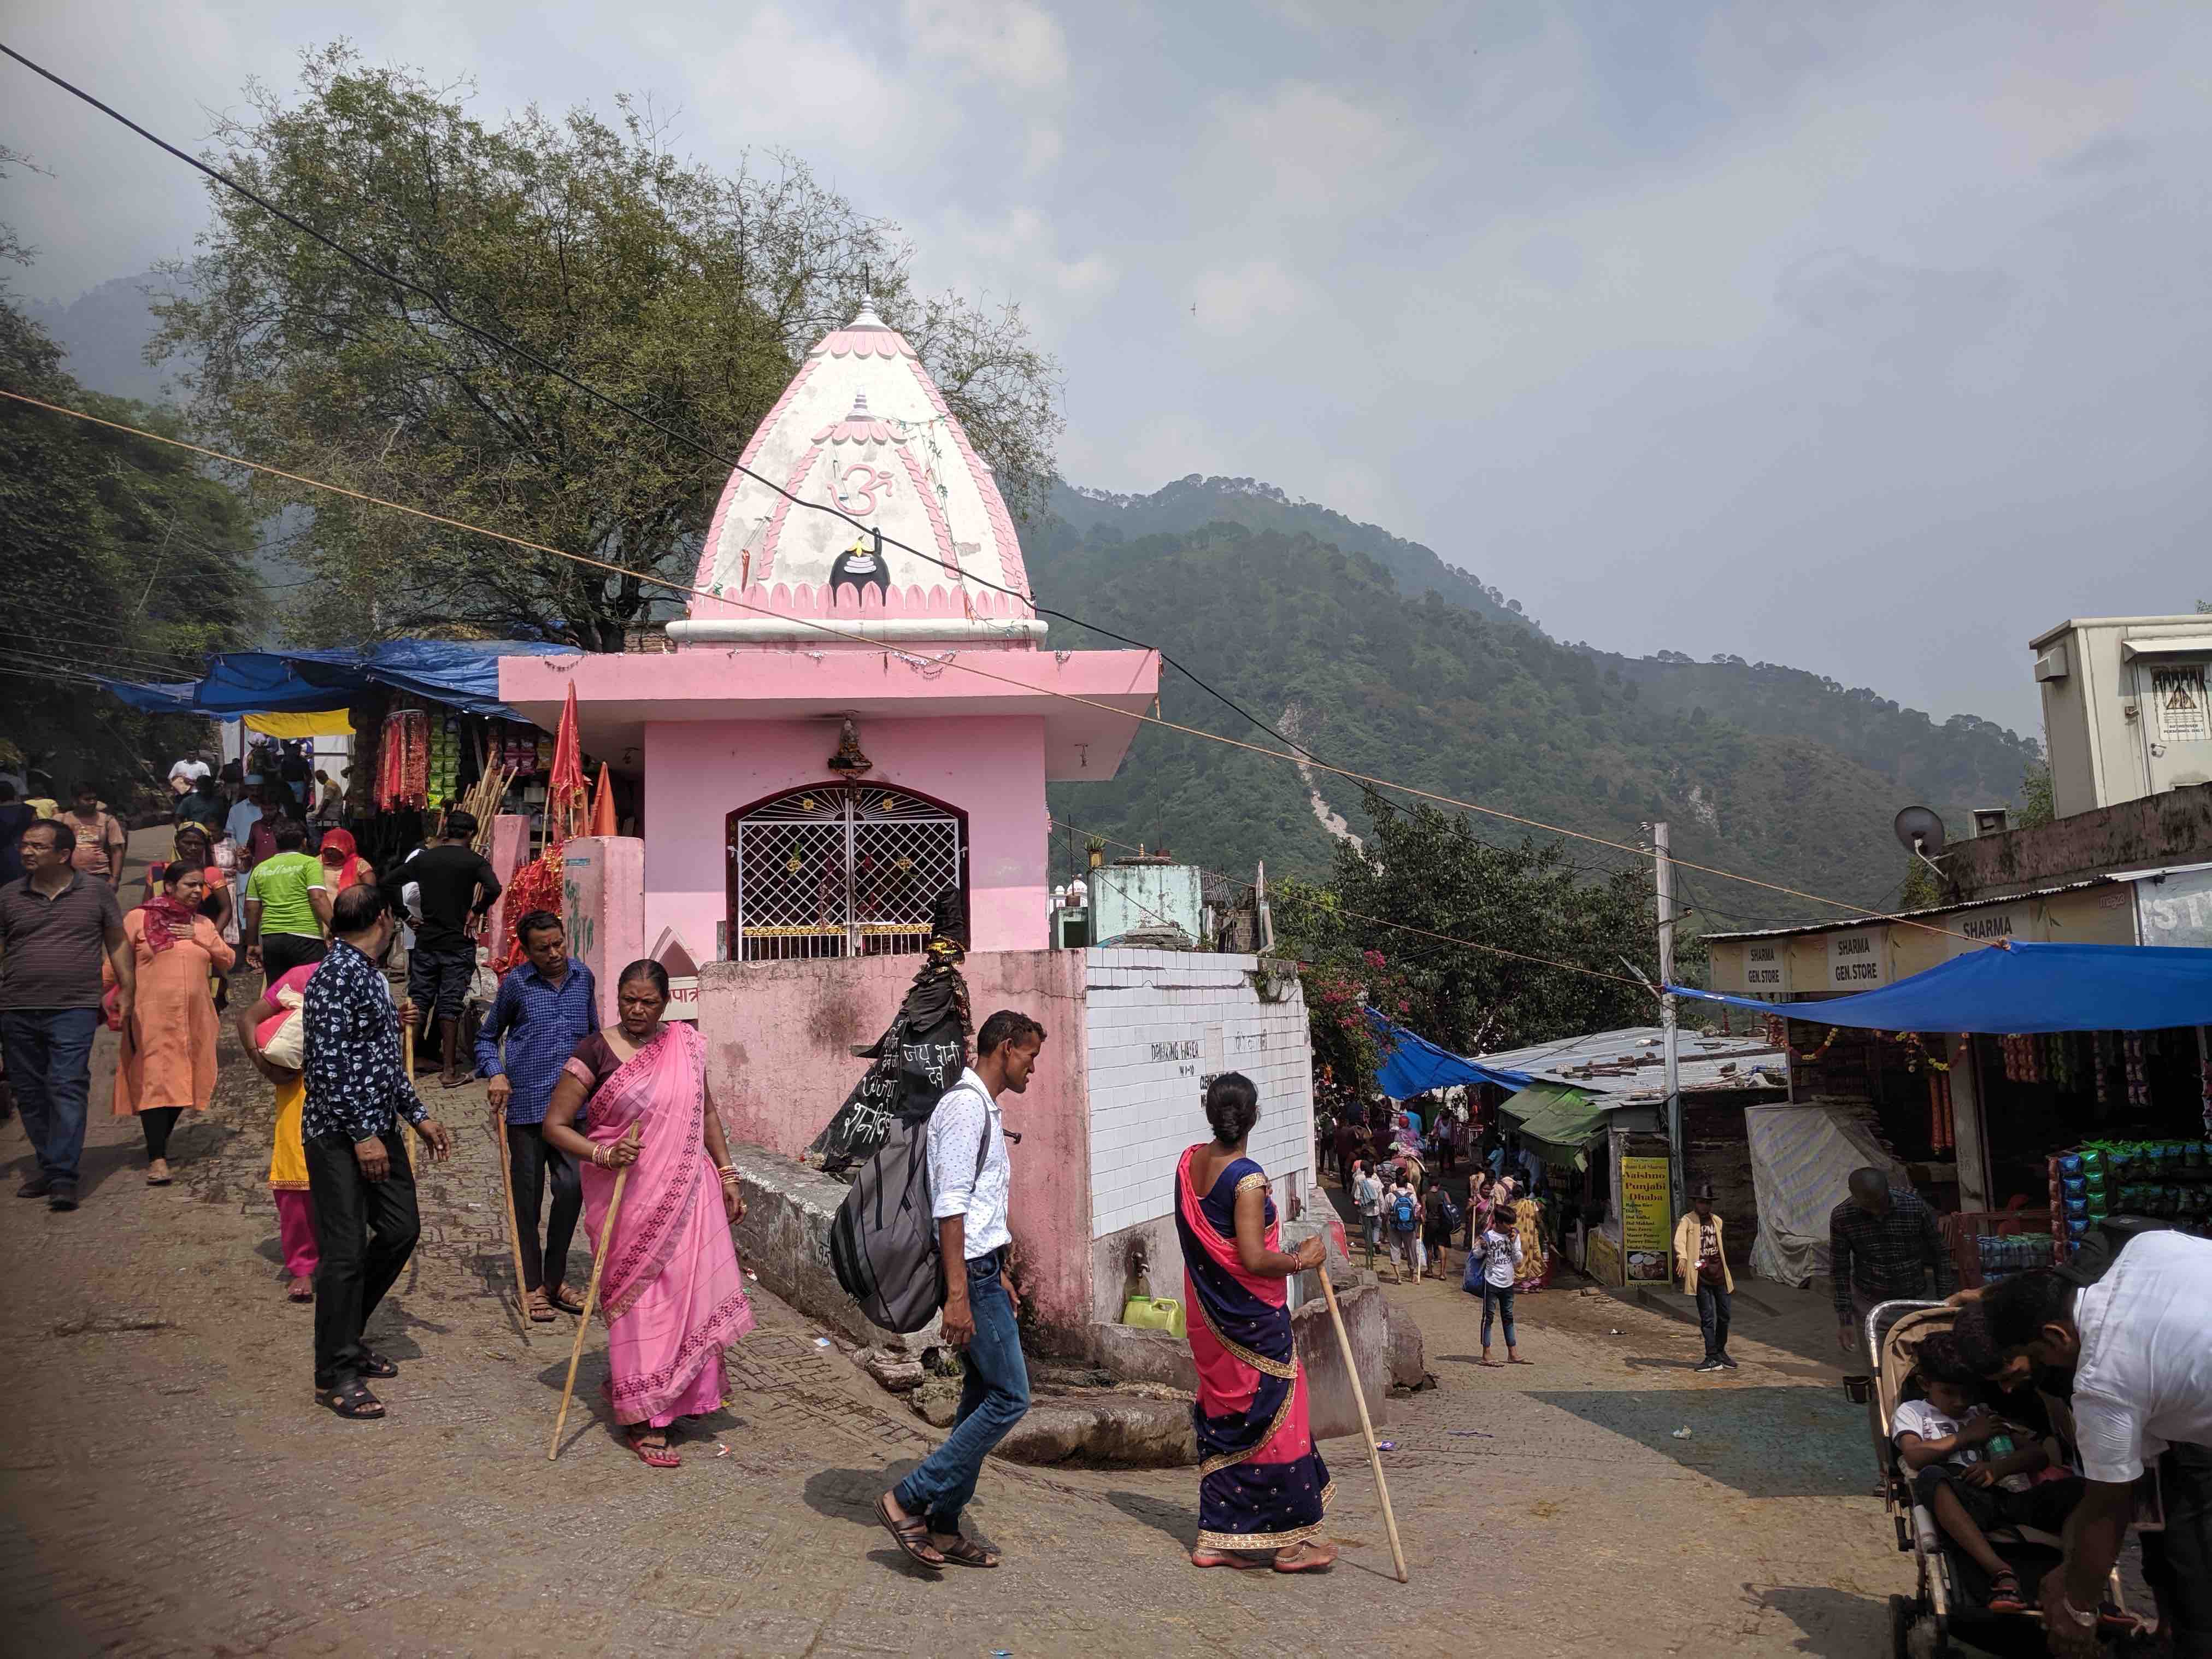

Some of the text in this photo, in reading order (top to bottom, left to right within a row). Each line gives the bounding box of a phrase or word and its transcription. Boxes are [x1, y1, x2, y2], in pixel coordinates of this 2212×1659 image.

[1963, 916, 2013, 938] SHARMA
[1751, 948, 1775, 962] SHARMA
[1838, 937, 1870, 956] SHARMA
[1761, 969, 1779, 983] STORE
[1852, 963, 1877, 980] STORE
[903, 1044, 931, 1061] जय
[925, 1060, 944, 1089] देव
[1626, 1183, 1666, 1191] Punjabi
